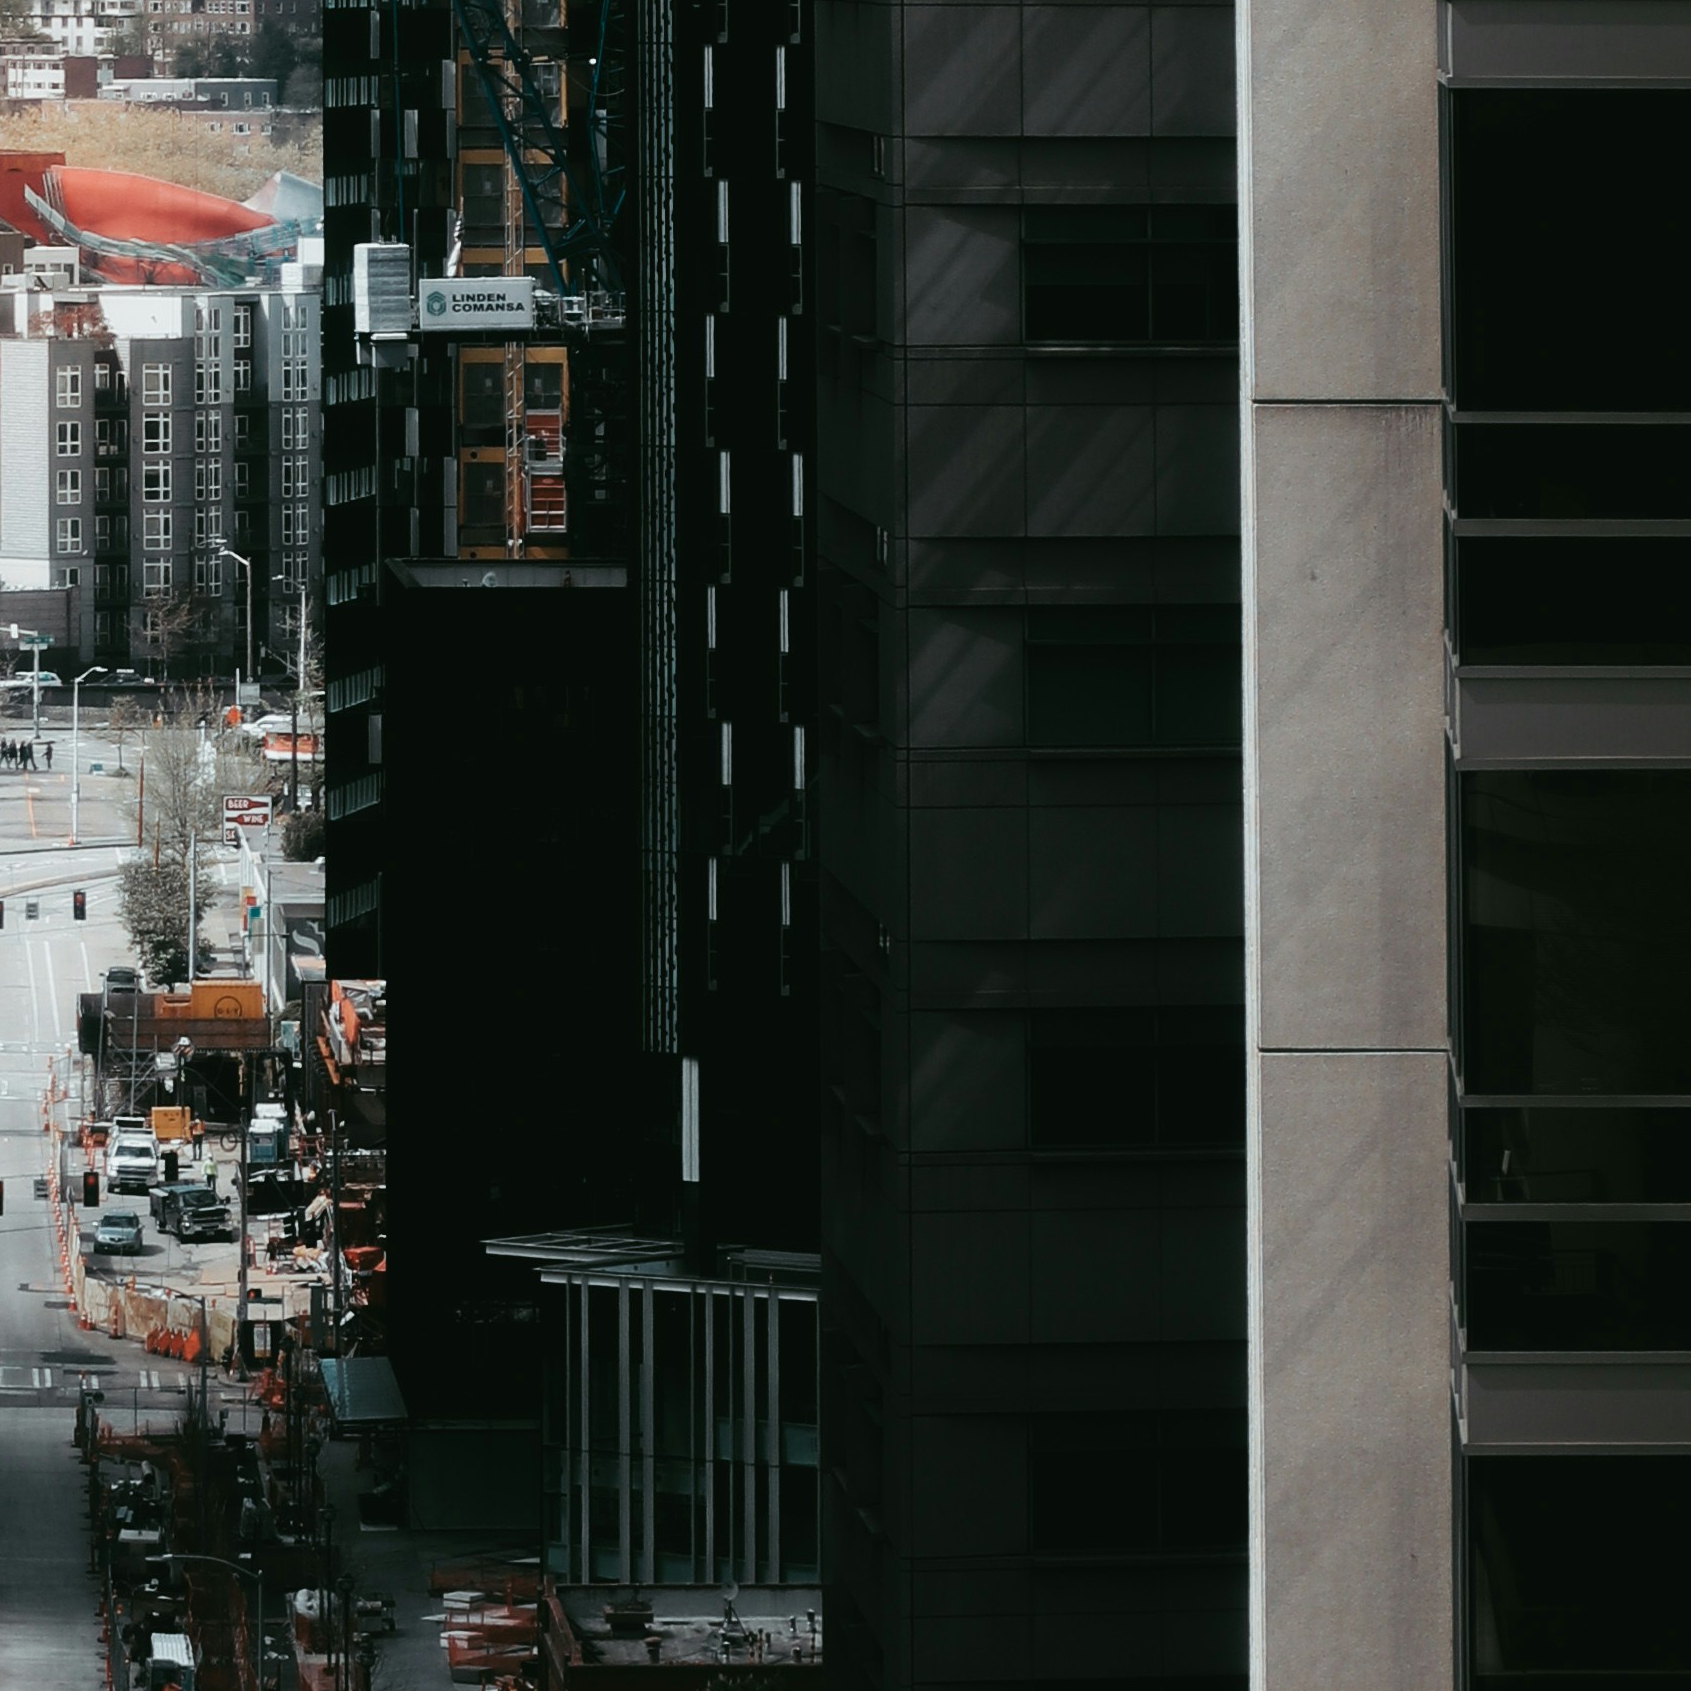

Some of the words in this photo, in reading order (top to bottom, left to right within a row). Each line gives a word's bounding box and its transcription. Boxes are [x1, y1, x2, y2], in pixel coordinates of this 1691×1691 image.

[452, 293, 506, 302] LINDEN
[452, 303, 525, 312] COMANSA
[228, 799, 249, 809] BEER
[242, 814, 265, 824] WINE
